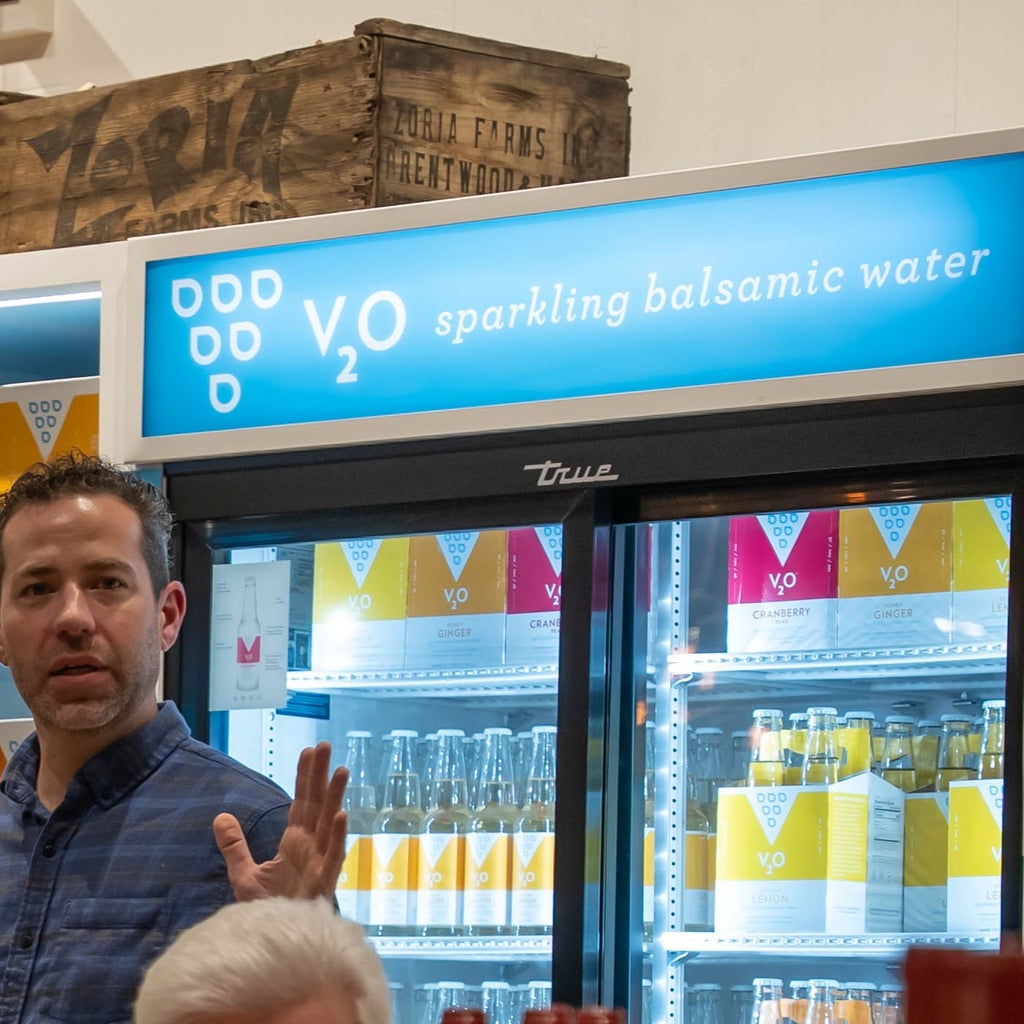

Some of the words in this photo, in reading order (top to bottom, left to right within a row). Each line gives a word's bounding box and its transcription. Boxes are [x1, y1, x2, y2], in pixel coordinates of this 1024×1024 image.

[394, 104, 457, 145] ZORIA
[474, 116, 546, 160] FARMS
[303, 290, 407, 384] V2O
[435, 282, 630, 345] sparkling
[644, 259, 845, 314] balsamic
[859, 247, 991, 289] water
[523, 460, 619, 487] true
[769, 572, 797, 596] V2O
[880, 565, 909, 590] V2O
[443, 587, 469, 610] V2O
[752, 607, 811, 620] CRANBERRY
[873, 608, 913, 620] GINGER
[437, 628, 472, 639] GINGER
[757, 851, 786, 876] V2O
[752, 894, 789, 904] LEMON
